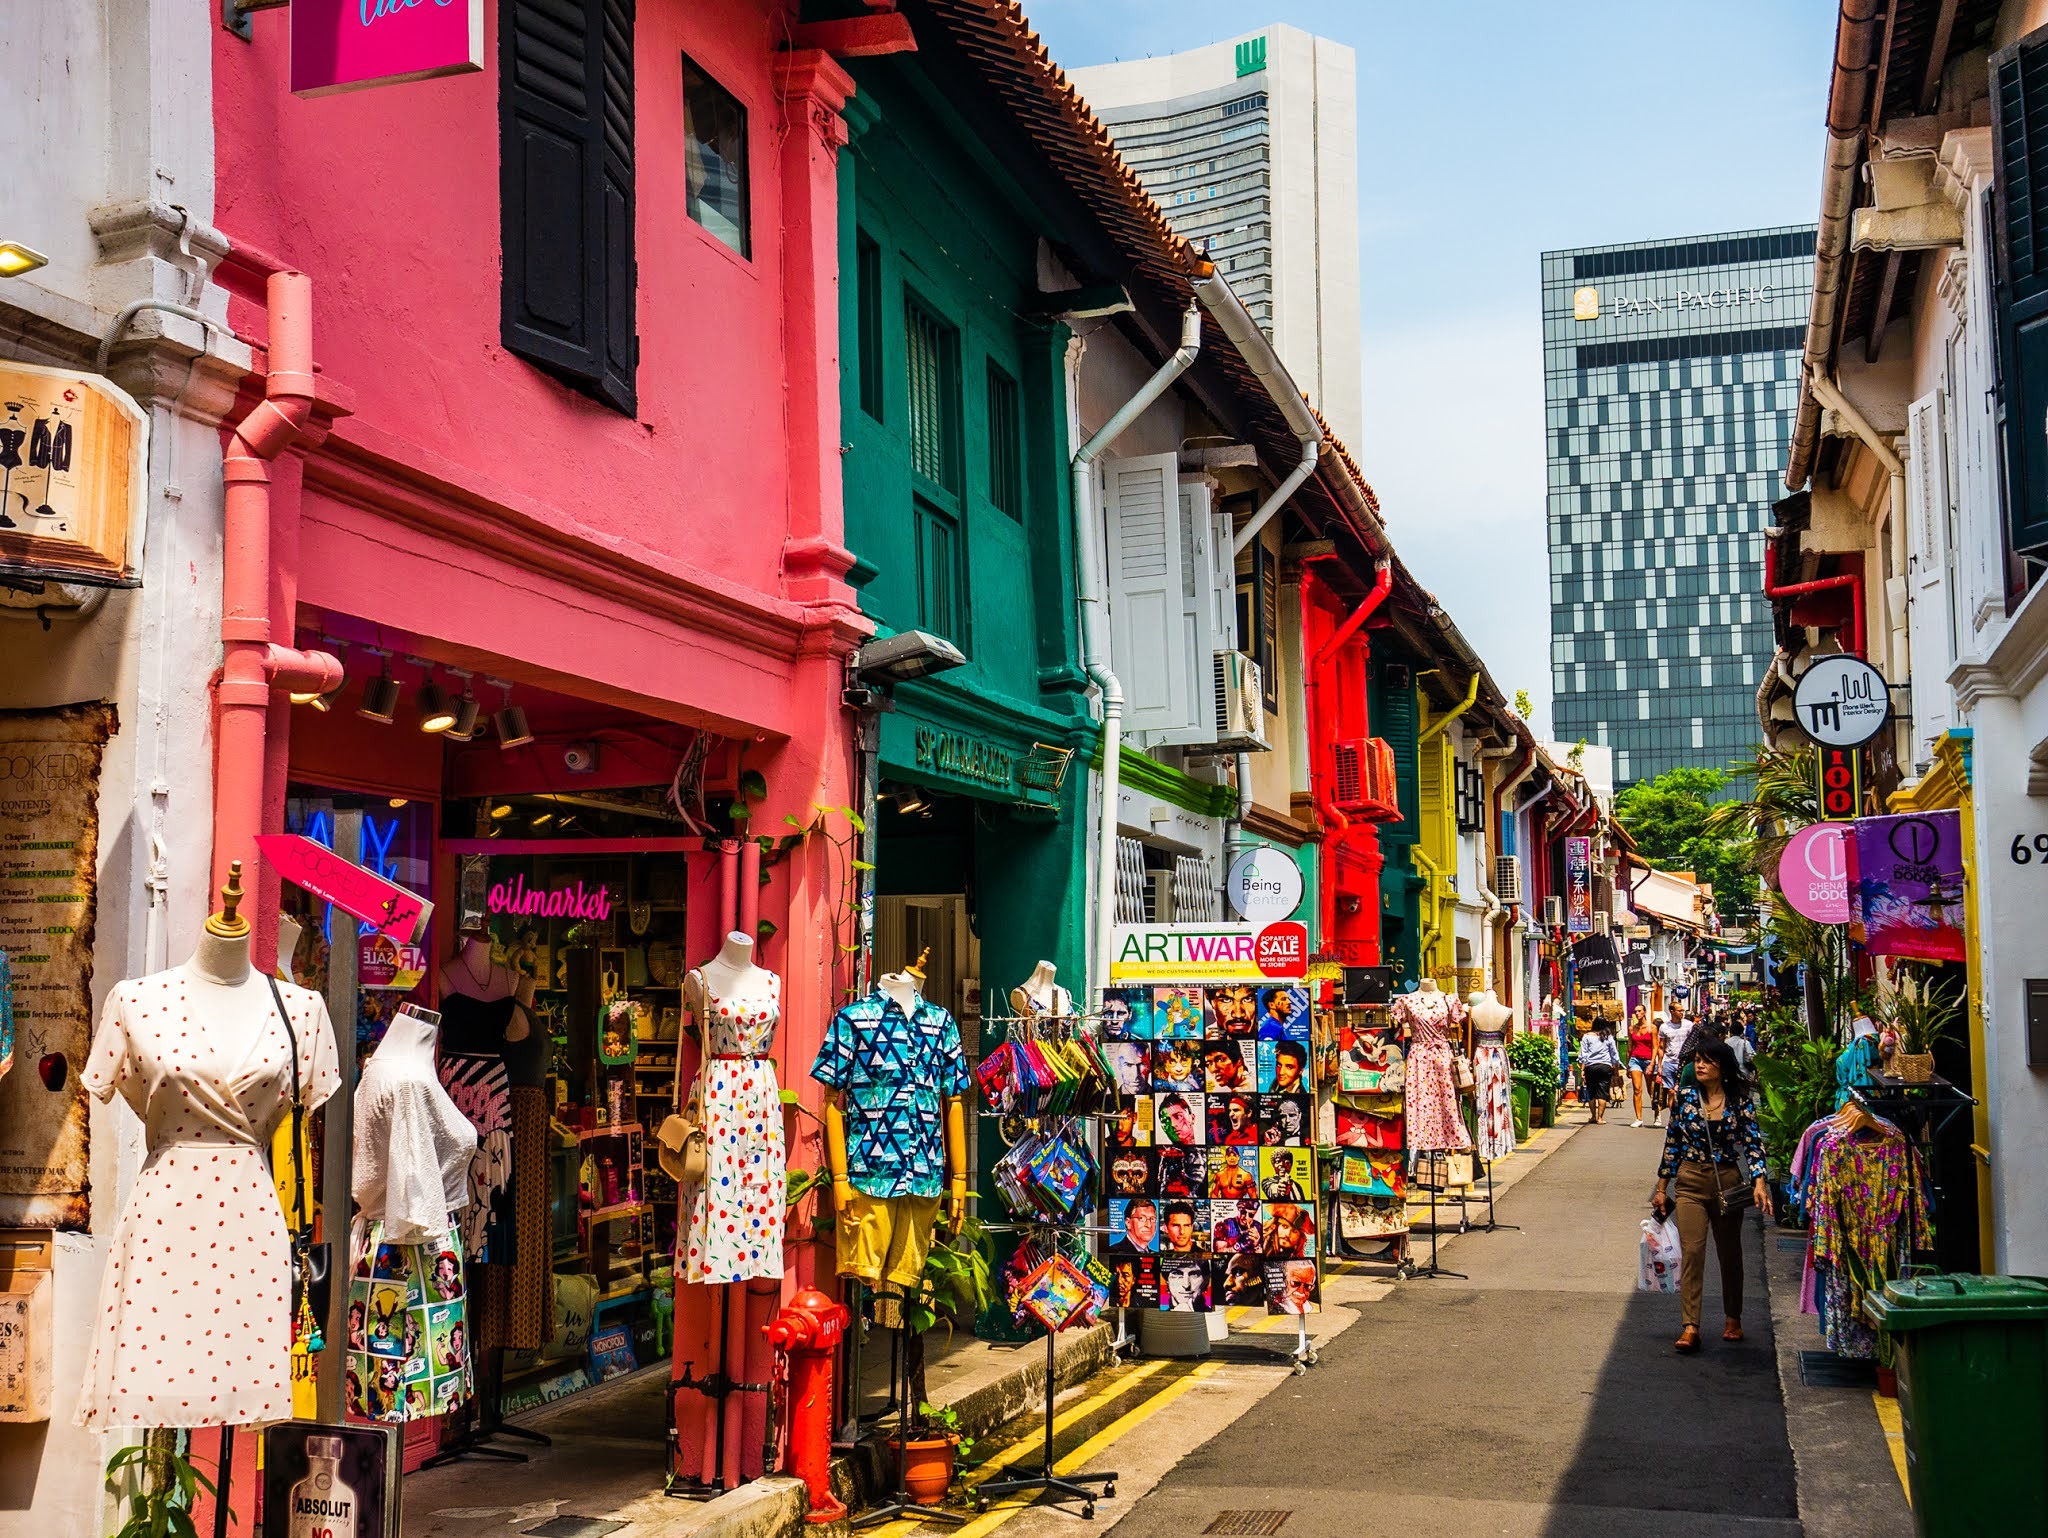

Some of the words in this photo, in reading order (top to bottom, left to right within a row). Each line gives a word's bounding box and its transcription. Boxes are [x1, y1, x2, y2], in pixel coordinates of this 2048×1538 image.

[1613, 295, 1663, 317] PAN
[1676, 284, 1775, 312] PACIFIC
[1864, 708, 1884, 716] Design
[16, 780, 35, 792] ON
[1, 800, 51, 810] CONTENTS
[4, 833, 31, 842] Chapter
[20, 841, 75, 851] SPOILMARKET
[3, 861, 30, 869] Chapter
[290, 842, 369, 898] HOOKED
[9, 870, 37, 878] LADIES
[37, 869, 76, 878] APPARELS
[1242, 878, 1281, 894] Being
[2, 889, 28, 898] Chapter
[322, 891, 336, 902] Lane
[488, 873, 611, 920] oilmarket
[1808, 890, 1848, 901] DODG
[37, 895, 84, 903] SUNGLASSES
[1242, 893, 1289, 906] Centre
[1, 917, 27, 925] Chapter
[48, 926, 75, 934] CLOCK
[1, 945, 27, 953] Chapter
[1260, 940, 1299, 956] SALE
[1632, 942, 1647, 950] SUP
[1308, 951, 1341, 963] sale
[43, 1010, 63, 1019] happy
[12, 1166, 46, 1176] MYSTERY
[48, 1168, 66, 1176] MAN
[1086, 1264, 1111, 1287] MENACE
[823, 1317, 839, 1337] 1091
[594, 1334, 626, 1352] MONOPOLY
[296, 1498, 351, 1518] ABSOLUT
